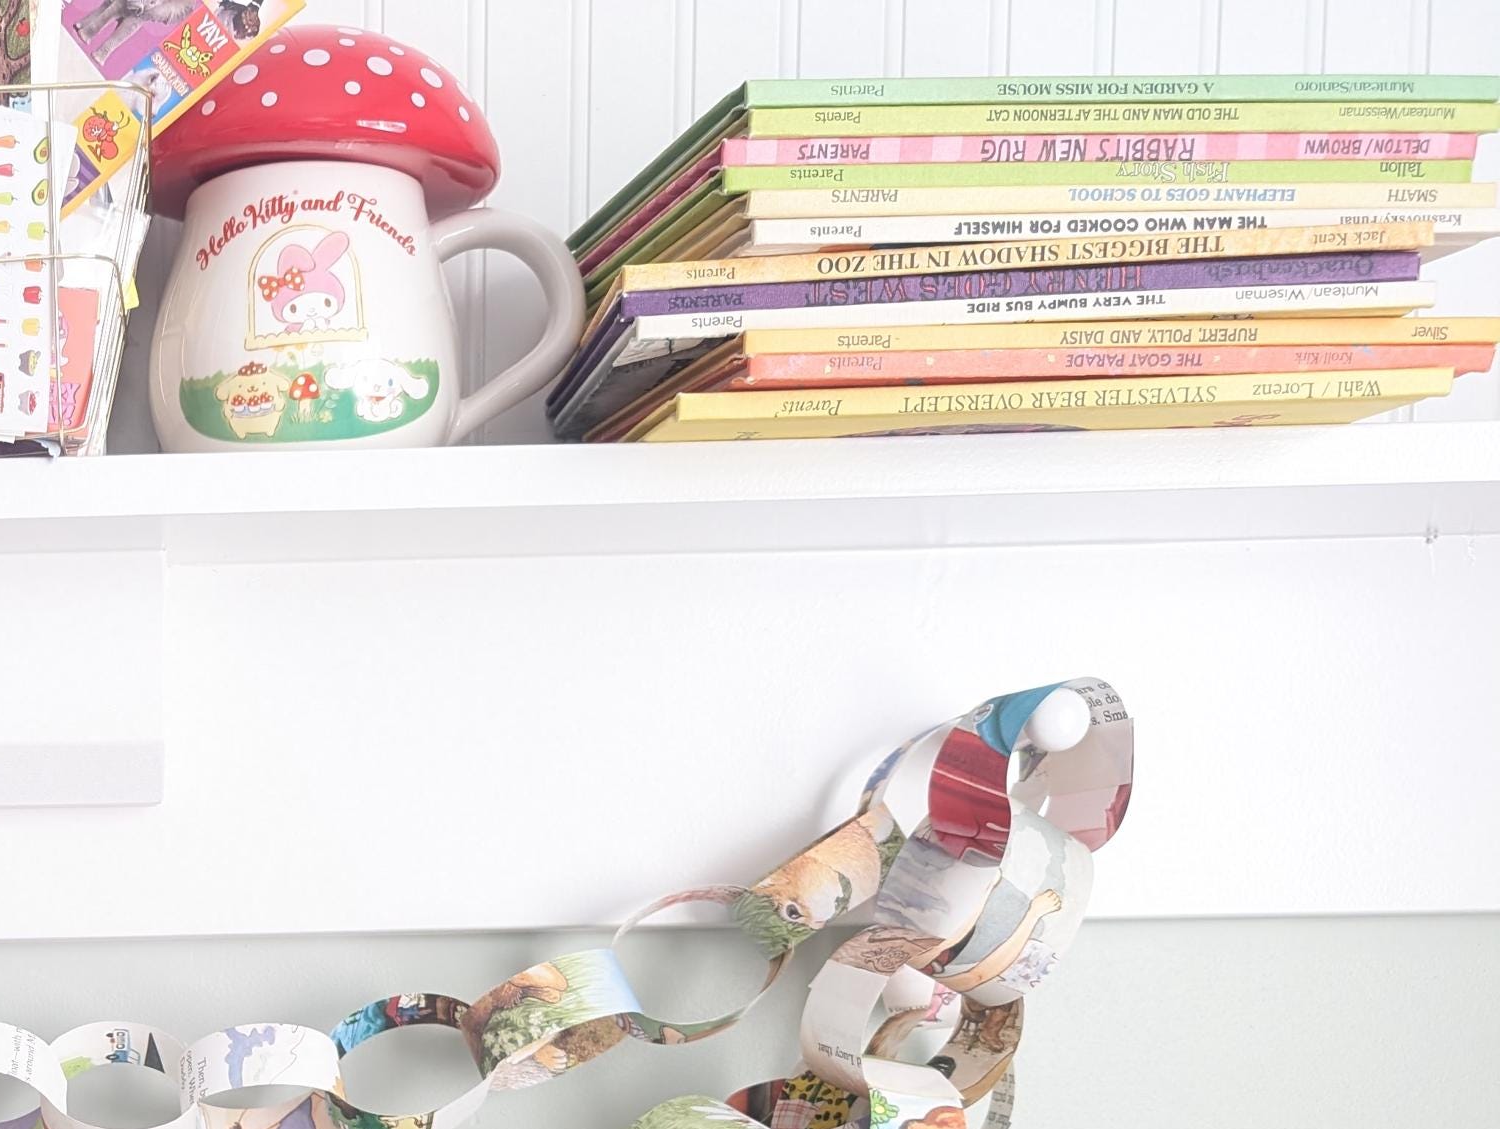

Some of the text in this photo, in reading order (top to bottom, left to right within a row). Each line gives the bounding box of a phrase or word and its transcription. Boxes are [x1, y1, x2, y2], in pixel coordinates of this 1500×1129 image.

[196, 13, 228, 52] YAY!
[830, 84, 884, 96] Parents
[997, 83, 1214, 96] A GARDEN FOR MISS MOUSE
[1295, 81, 1415, 94] Muntean/Santoro
[815, 111, 861, 124] Parents
[986, 107, 1239, 122] THE OLD MAN AND THE AFTERNOON CAT
[1339, 107, 1455, 119] Muntean/Weissman
[797, 143, 870, 160] PARENTS
[981, 138, 1195, 162] RABBIT'S NEW RUG
[790, 169, 844, 181] Parents
[1116, 161, 1230, 183] Fish Story
[1380, 161, 1425, 177] Tallon
[831, 190, 898, 203] PARENTS
[1068, 188, 1296, 202] ELEPHANT GOES TO SCHOOL
[1388, 189, 1437, 202] SMATH
[196, 190, 416, 271] Hello Kitty and Friends
[810, 225, 862, 238] Parents
[954, 216, 1267, 235] THE MAN WHO COOKED FOR HIMSELF
[1313, 231, 1386, 246] Jack Kent
[817, 236, 1225, 275] THE BIGGEST SHADOW IN THE ZOO
[686, 267, 736, 280] Parents
[805, 265, 1143, 306] HENRY GOES WEST
[1235, 286, 1379, 301] Muntean/Wiseman
[668, 292, 744, 311] PARENTS
[967, 294, 1166, 313] THE VERY BUMPY BUS RIDE
[692, 315, 742, 328] Parents
[1060, 328, 1258, 345] RUPERT, POLLY, AND DAISY
[1412, 326, 1448, 340] Silver
[838, 335, 891, 348] Parents
[829, 356, 883, 370] Parents
[1065, 353, 1203, 368] THE GOAT PARADE
[1253, 382, 1314, 399] Lorenz
[1337, 380, 1381, 398] Wahl
[899, 386, 1217, 413] SYLVESTER BEAR OVERSLEPT
[835, 1046, 855, 1066] Lucy
